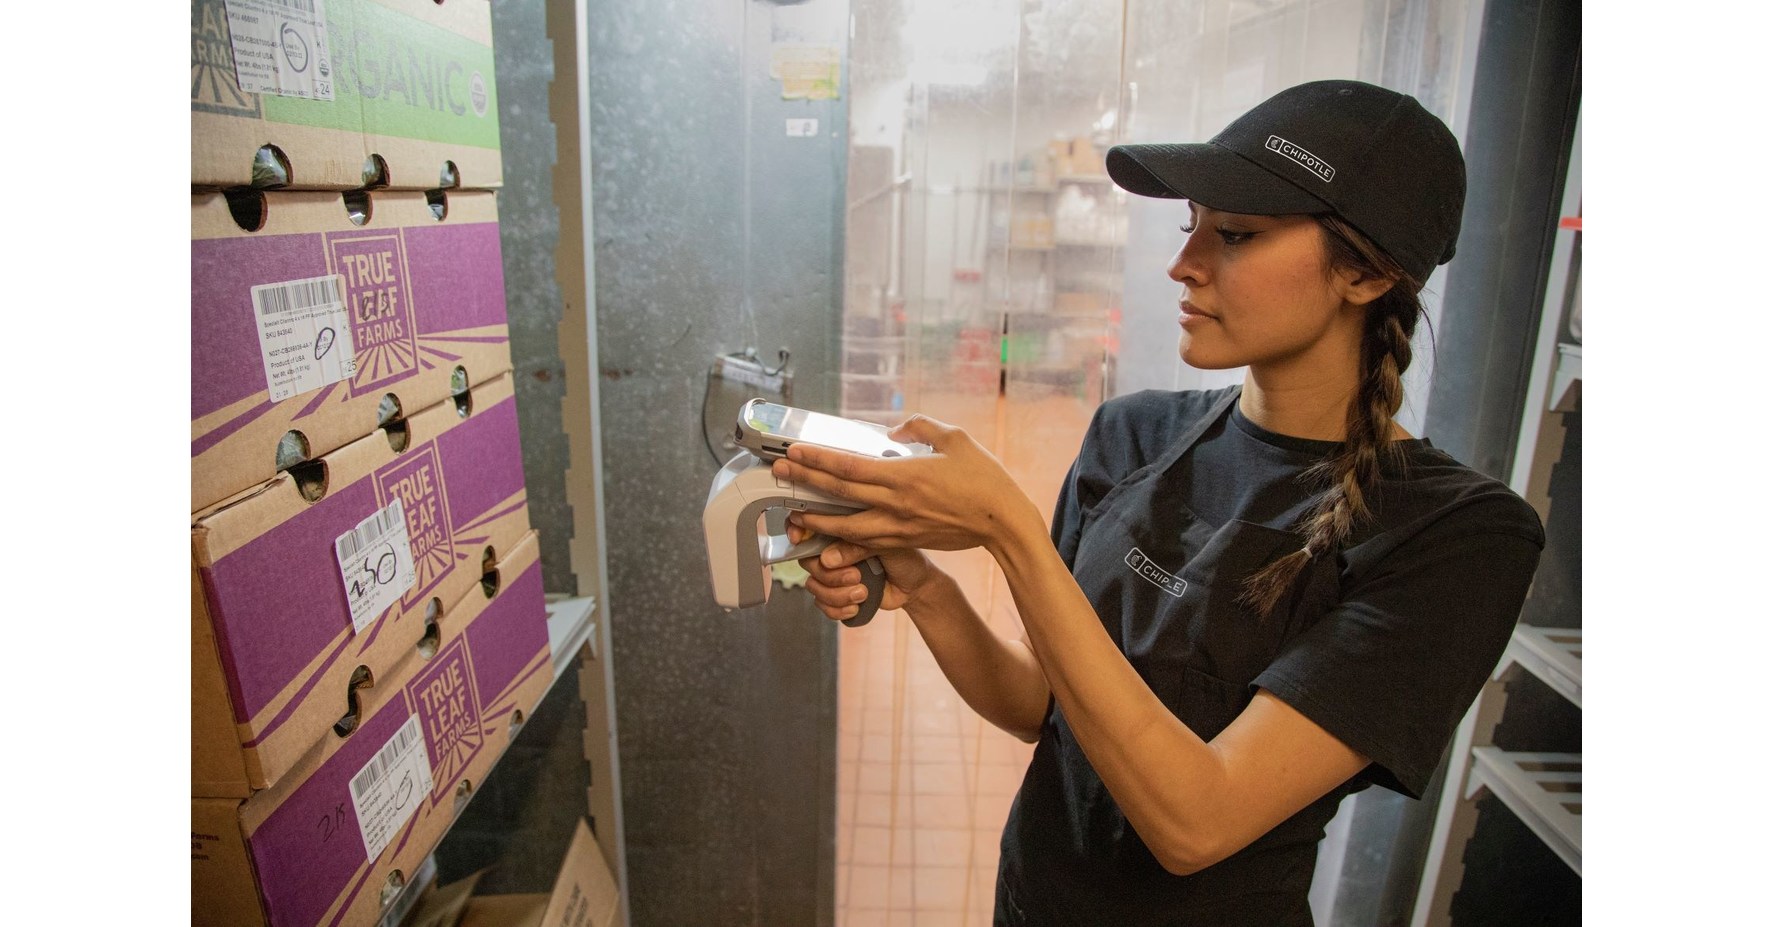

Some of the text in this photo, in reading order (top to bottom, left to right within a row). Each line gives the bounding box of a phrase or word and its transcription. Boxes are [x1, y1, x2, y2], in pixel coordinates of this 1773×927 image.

[326, 20, 466, 116] RGANIC
[1283, 145, 1331, 178] CHIPOTLE
[342, 251, 396, 288] TRUE
[352, 286, 398, 324] LEAF
[357, 319, 403, 348] FARMS
[347, 360, 357, 372] 25
[389, 464, 434, 509] TRUE
[407, 496, 436, 539] EAF
[411, 525, 442, 558] ARMS
[420, 658, 463, 716] TRUE
[429, 685, 465, 743] LEAF
[435, 711, 471, 762] FARMS
